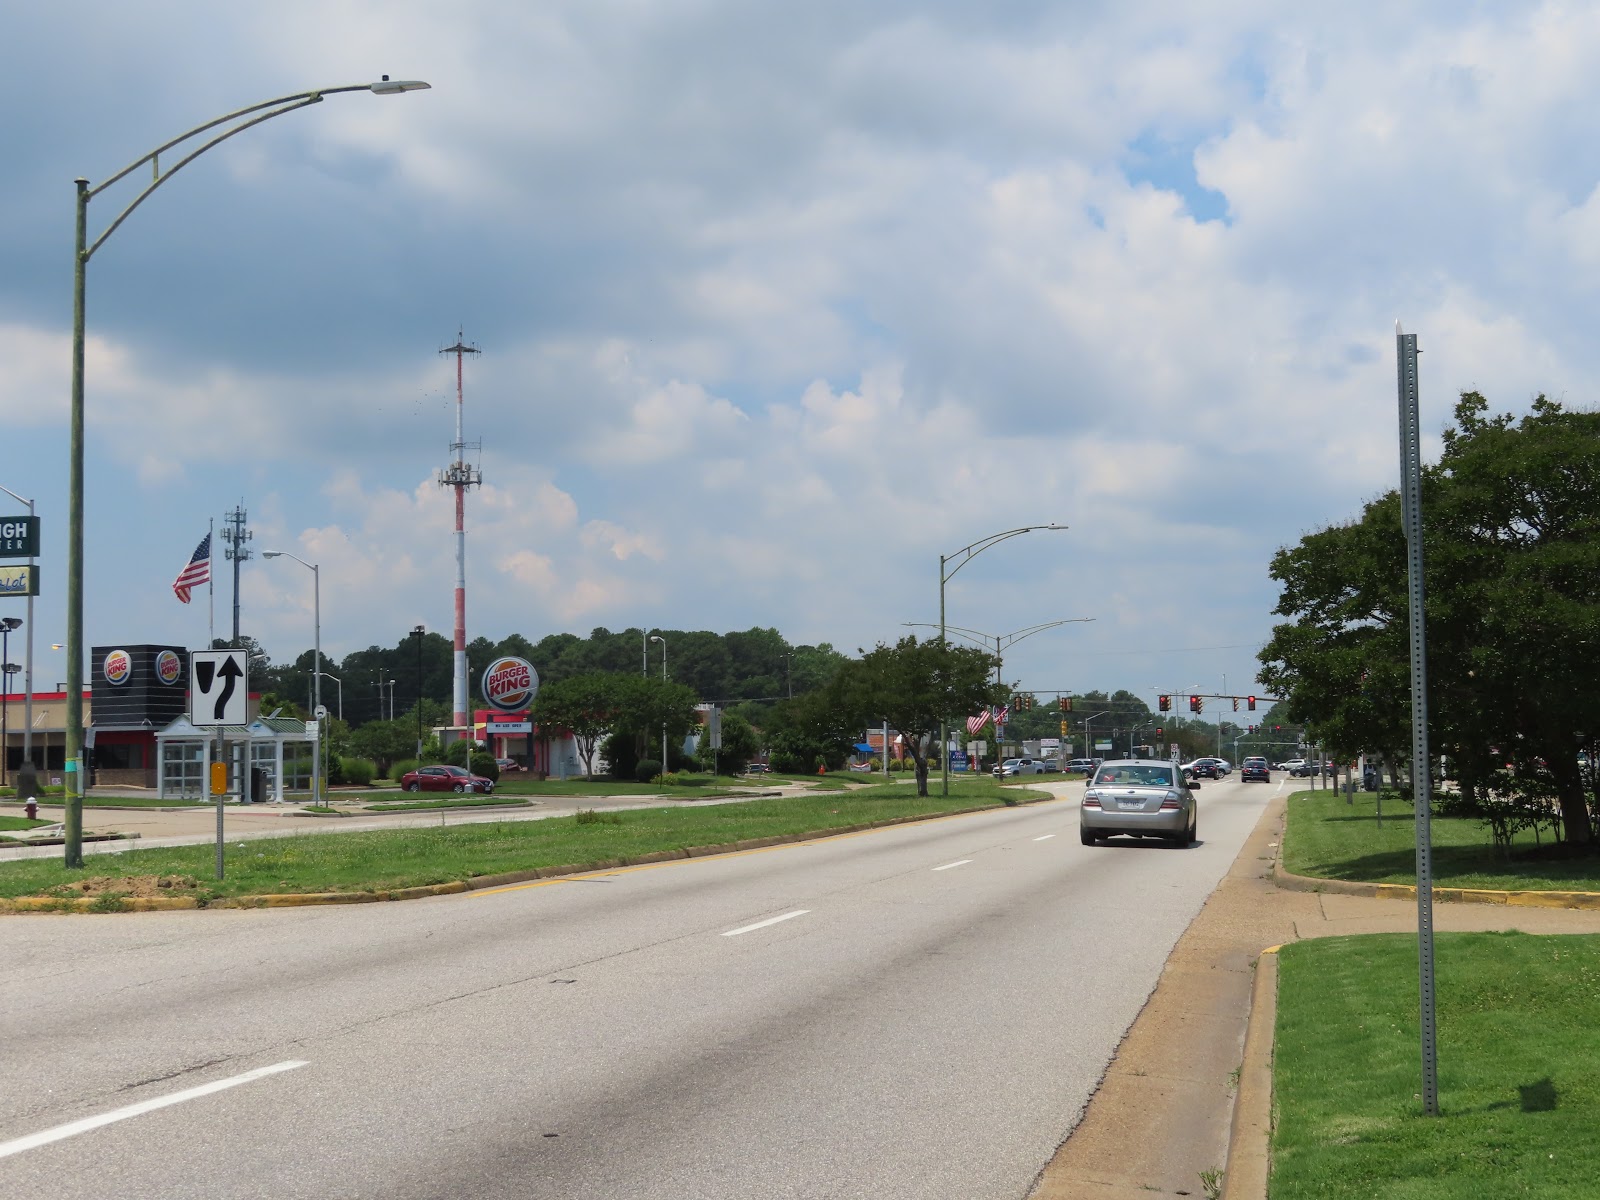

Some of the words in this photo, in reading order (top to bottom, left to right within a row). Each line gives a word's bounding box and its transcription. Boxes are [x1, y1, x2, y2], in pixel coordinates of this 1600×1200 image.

[108, 657, 126, 667] BURGER
[161, 657, 177, 668] BURGER
[108, 663, 127, 676] KING
[161, 663, 178, 676] KING
[489, 666, 528, 685] BURGER
[489, 675, 530, 697] KING
